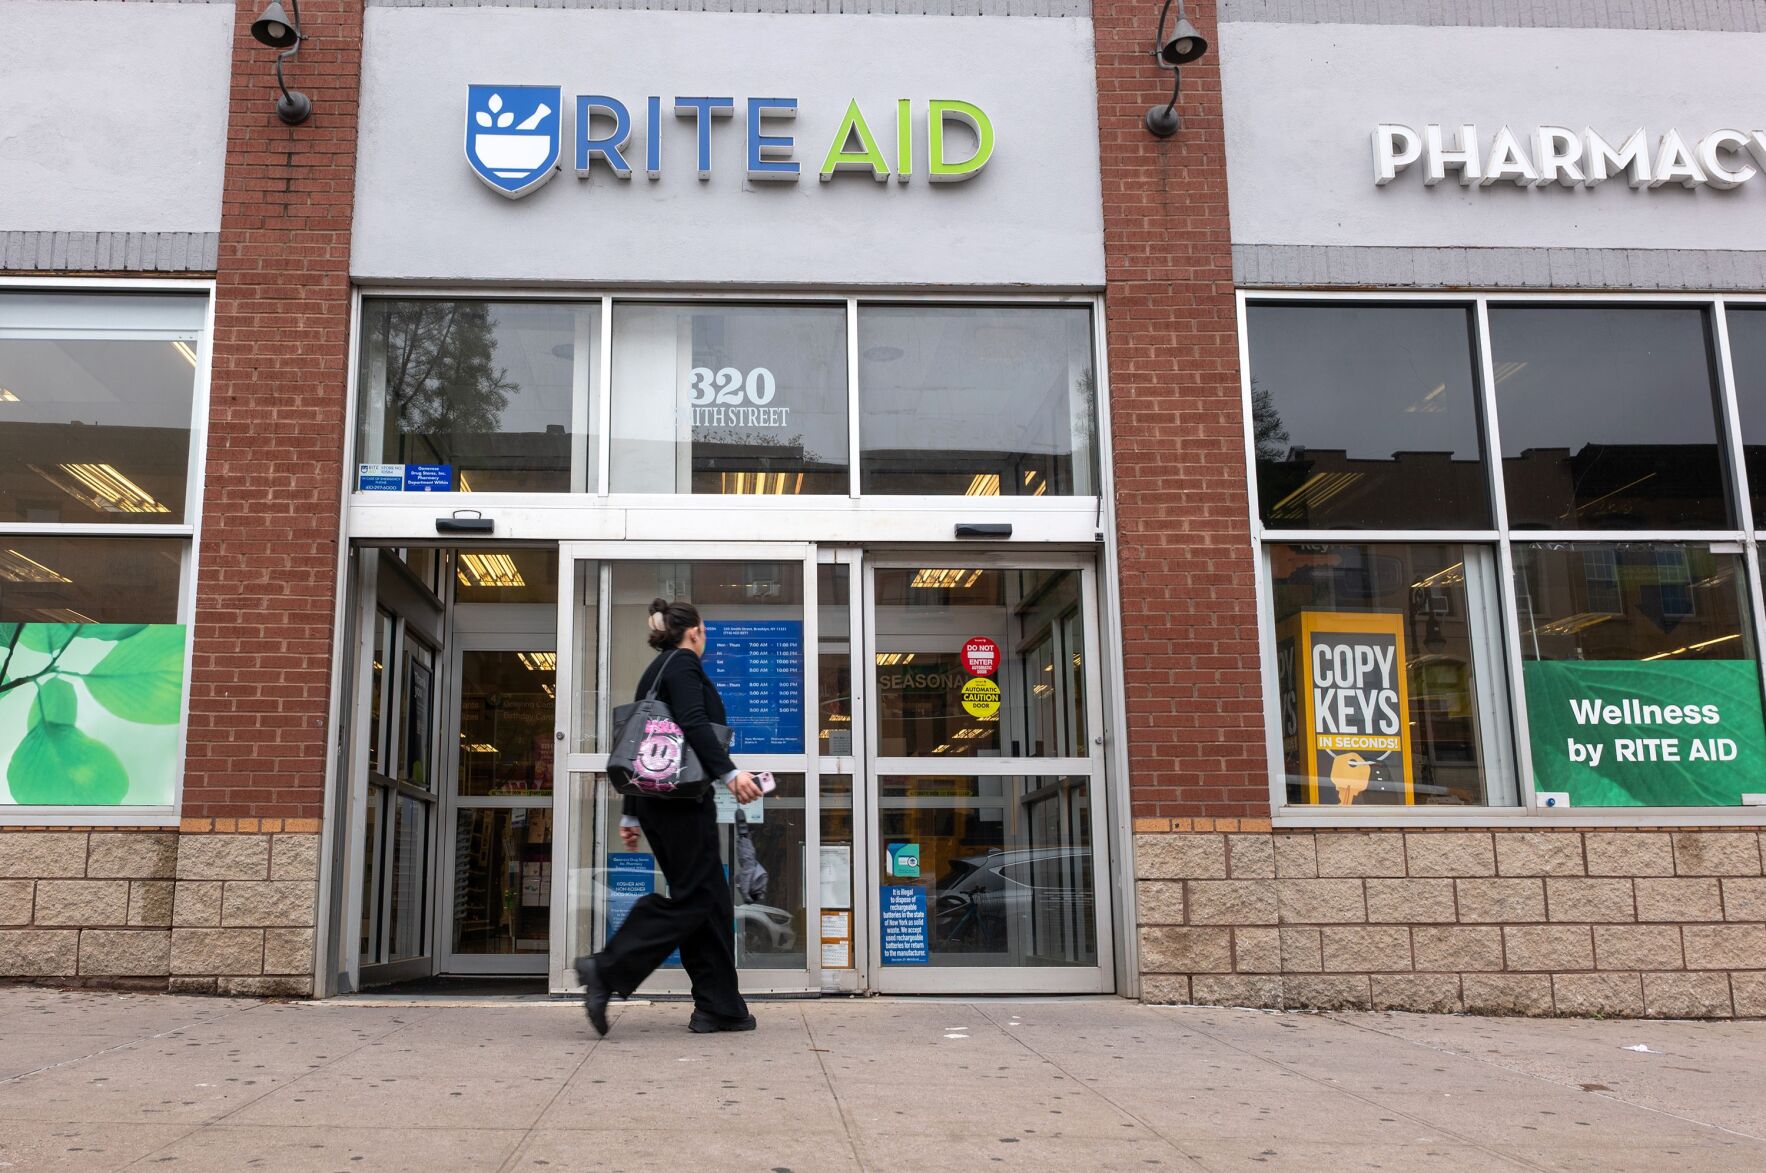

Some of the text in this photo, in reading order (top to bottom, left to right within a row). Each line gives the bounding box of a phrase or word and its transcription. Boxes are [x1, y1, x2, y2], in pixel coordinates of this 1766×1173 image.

[574, 95, 995, 183] RITE AID
[688, 367, 775, 405] 320
[729, 408, 789, 426] STREET
[1312, 644, 1395, 688] COPY
[880, 674, 967, 689] SEASONA
[1314, 688, 1399, 735] KEYS
[1569, 699, 1720, 725] Wellness
[1320, 737, 1398, 748] IN SECONDS!
[1567, 738, 1737, 767] by RITE AID
[896, 896, 911, 904] dispose
